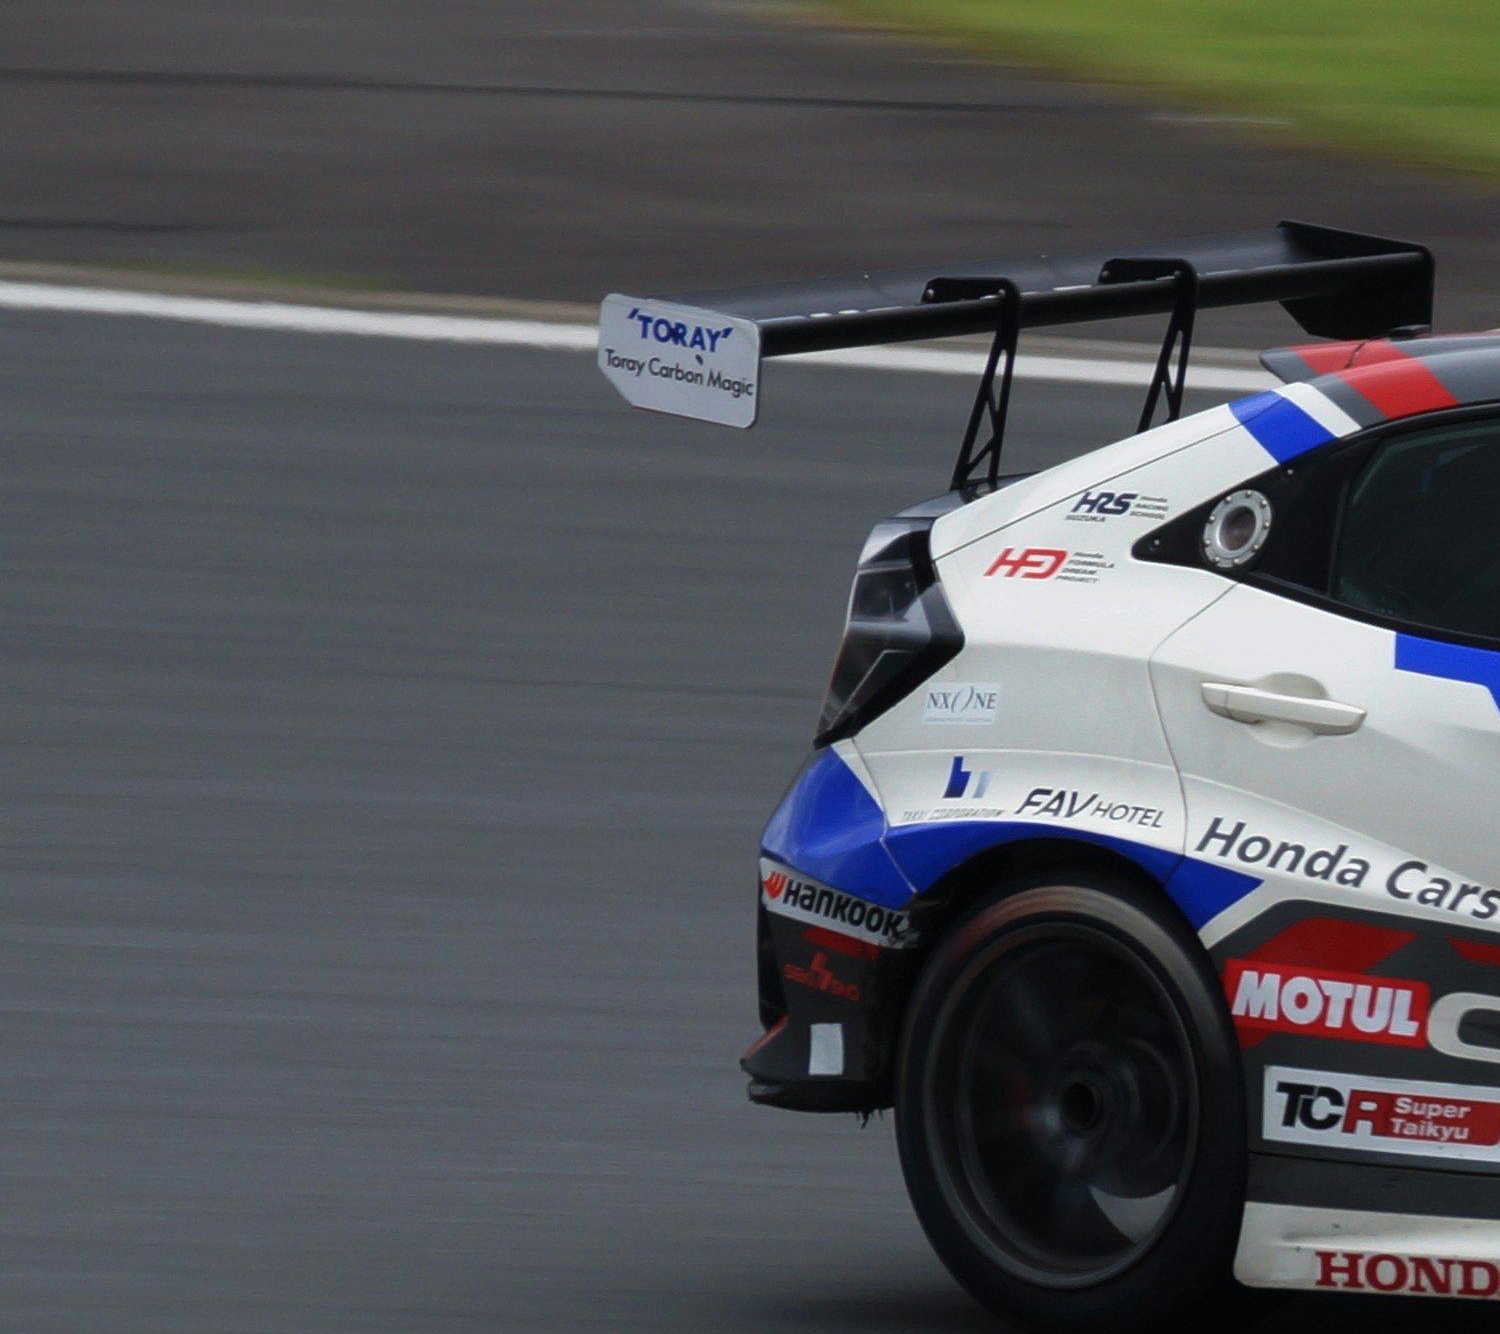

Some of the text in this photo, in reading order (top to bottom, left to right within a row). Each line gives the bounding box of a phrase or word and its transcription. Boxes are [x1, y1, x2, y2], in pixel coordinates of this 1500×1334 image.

[605, 348, 754, 398] Toray Carbon Magic
[1014, 788, 1164, 828] FAV HOTEL
[1195, 817, 1370, 889] Honda
[1231, 970, 1420, 1037] MOTUL
[1275, 1081, 1471, 1136] TCR Super
[1391, 1118, 1470, 1142] Taikyu
